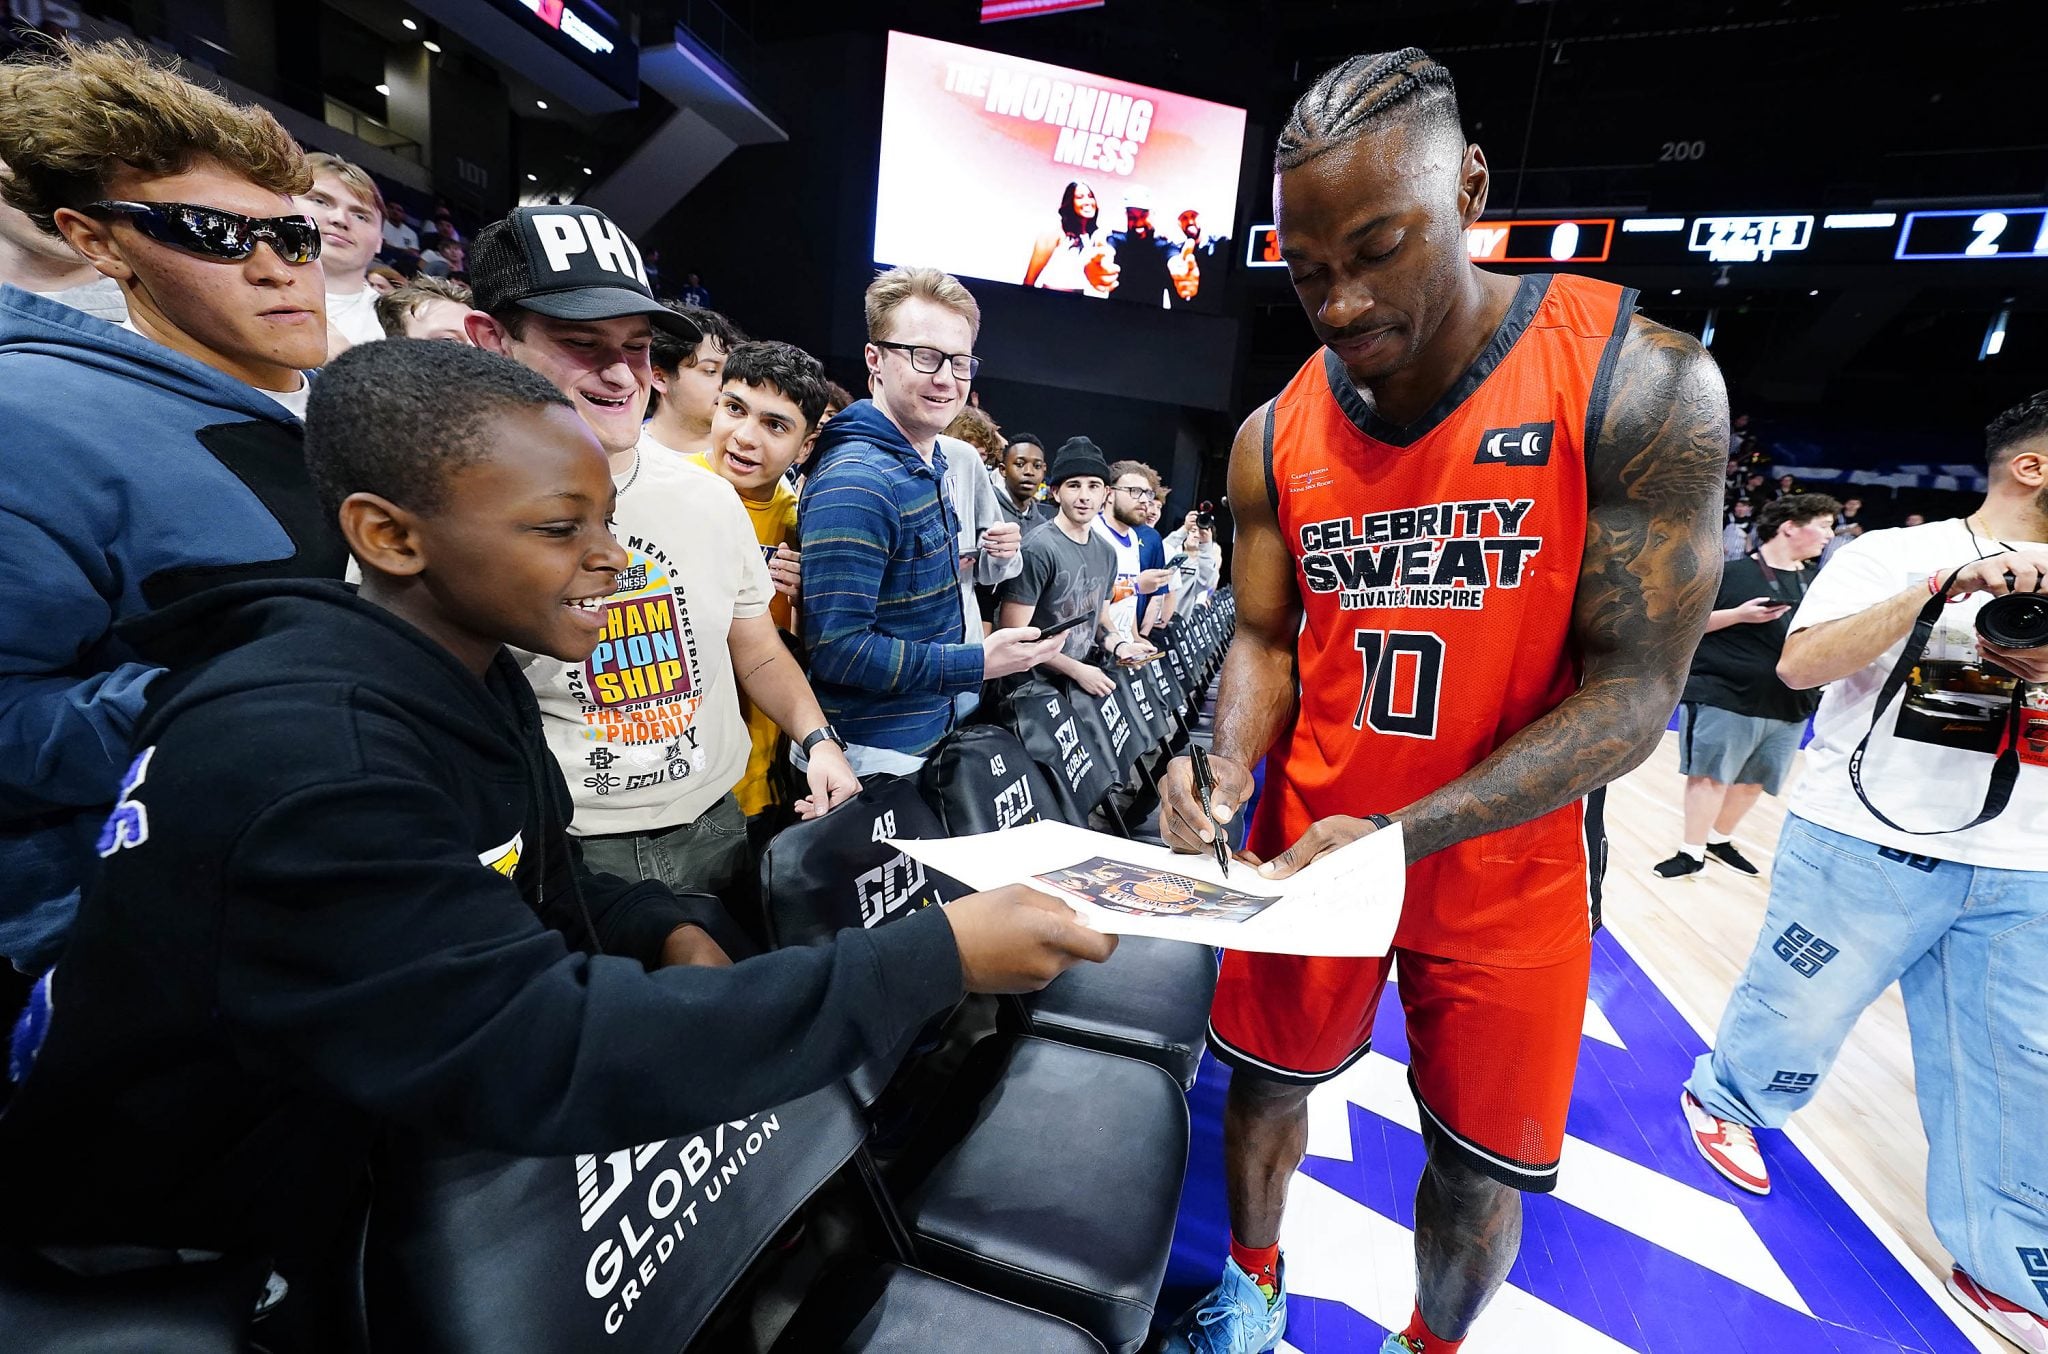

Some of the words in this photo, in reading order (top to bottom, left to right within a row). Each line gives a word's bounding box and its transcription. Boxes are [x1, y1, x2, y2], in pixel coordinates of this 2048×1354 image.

[945, 62, 986, 98] THE
[985, 68, 1154, 144] MORNING
[1053, 126, 1139, 177] MESS
[1660, 141, 1706, 161] 200
[1551, 222, 1579, 262] 0
[1965, 212, 2008, 256] 2
[1301, 499, 1535, 552] CELEBRITY
[617, 577, 647, 588] DNESS
[1302, 537, 1542, 593] SWEAT
[600, 600, 672, 641] HAM
[628, 535, 678, 578] MEN'S
[674, 586, 703, 687] BASKETBALL
[1340, 590, 1400, 610] OTIVATE
[1410, 588, 1484, 610] INSPIRE
[592, 631, 679, 675] PION
[594, 659, 683, 704] SHIP
[1353, 629, 1446, 740] 10
[583, 709, 625, 725] THE
[630, 703, 683, 723] ROAD
[625, 703, 651, 712] 2ND
[1047, 698, 1060, 718] 50
[1054, 715, 1079, 761] GCU
[625, 769, 665, 791] GCU
[989, 753, 1007, 777] 49
[993, 773, 1035, 830] GCU
[871, 809, 897, 843] 48
[854, 852, 929, 929] GCU
[586, 1113, 758, 1299] GLOB
[605, 1200, 698, 1335] CREDIT
[705, 1113, 781, 1203] UNION
